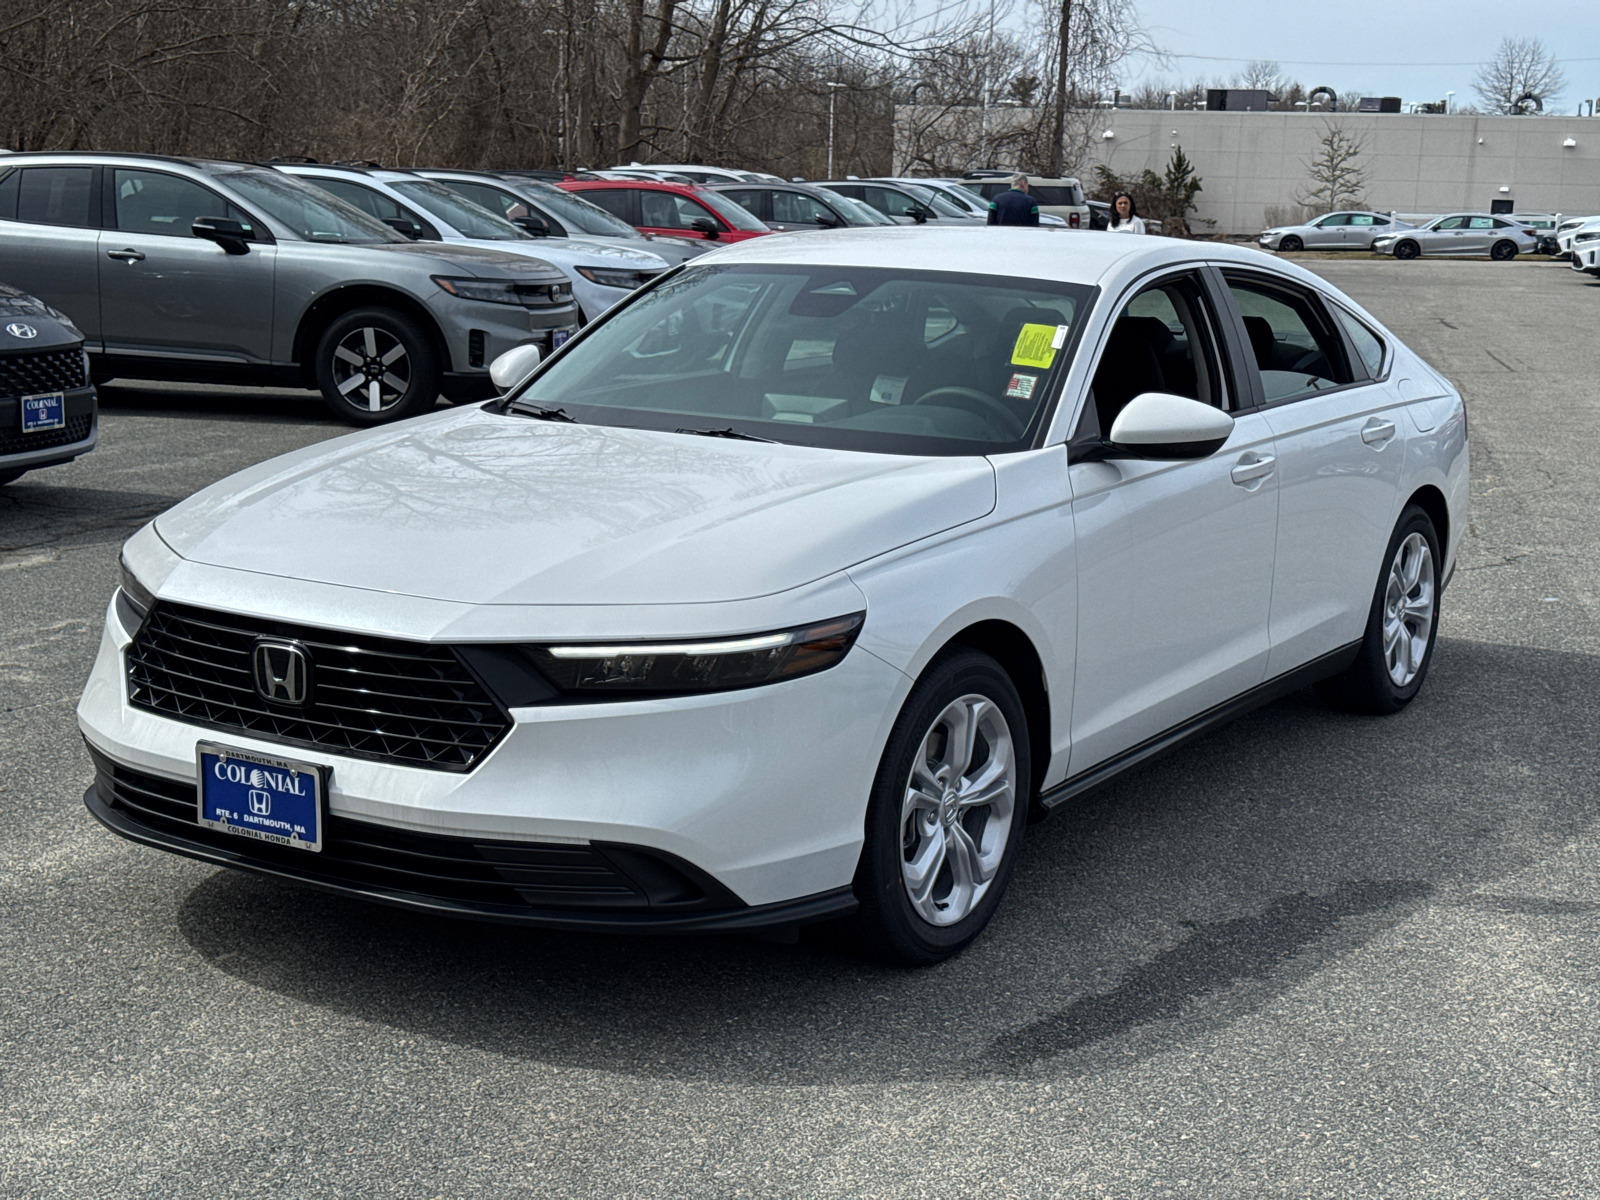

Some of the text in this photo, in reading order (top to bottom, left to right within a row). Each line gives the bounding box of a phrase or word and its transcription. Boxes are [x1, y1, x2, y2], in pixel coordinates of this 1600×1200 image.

[27, 398, 59, 410] COLONIAL
[276, 760, 289, 769] MA
[214, 761, 306, 797] COLONIAL
[215, 808, 306, 834] RTE. 6 DARTMOUTH, MA
[227, 825, 291, 846] COLONIAL HONDA
